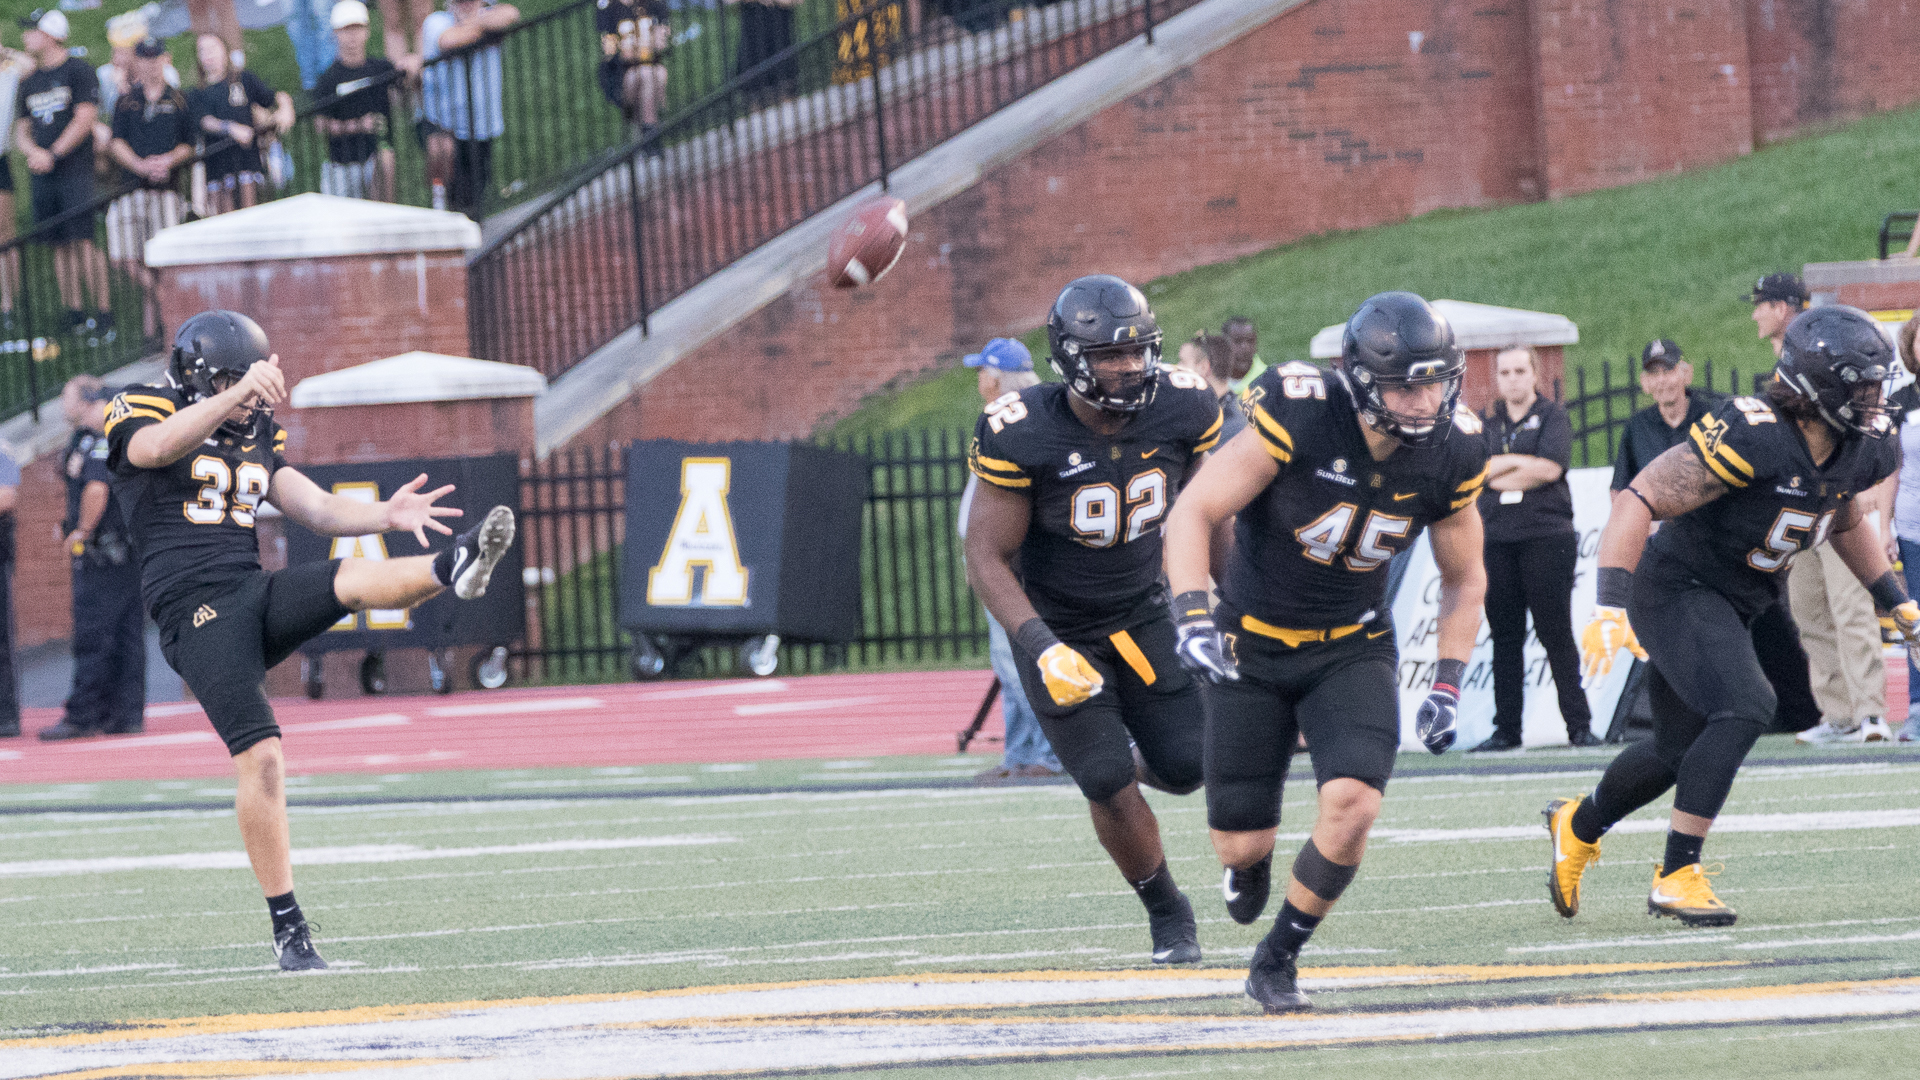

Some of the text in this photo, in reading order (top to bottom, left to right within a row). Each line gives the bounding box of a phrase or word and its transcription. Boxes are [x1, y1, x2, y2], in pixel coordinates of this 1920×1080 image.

[110, 391, 134, 423] A
[1278, 361, 1326, 399] 45
[984, 391, 1028, 434] 92
[1734, 396, 1777, 426] 51
[183, 454, 270, 528] 39
[1069, 467, 1167, 549] 92
[647, 456, 750, 606] A
[1294, 501, 1413, 572] 45
